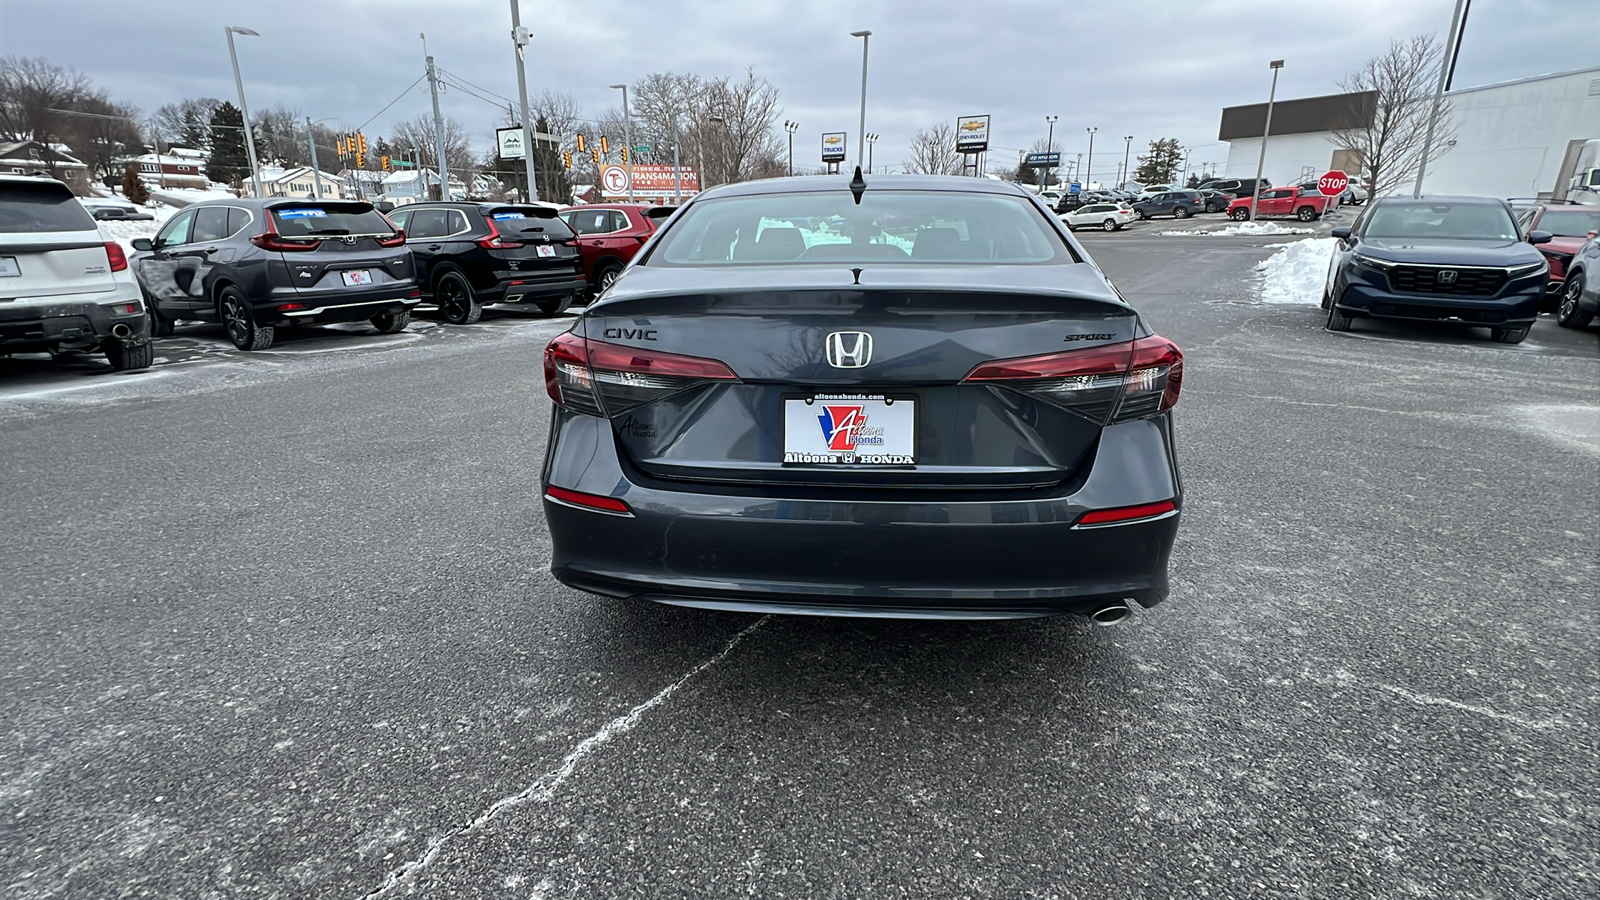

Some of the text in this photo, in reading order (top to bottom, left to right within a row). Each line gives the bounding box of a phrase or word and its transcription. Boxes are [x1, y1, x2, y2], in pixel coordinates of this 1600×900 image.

[1320, 178, 1346, 188] STOP
[603, 328, 658, 341] CIVIC
[1063, 333, 1117, 342] SPORT
[620, 415, 654, 437] Altoona
[828, 410, 884, 445] Altoona
[632, 429, 656, 438] Honda
[850, 435, 883, 444] Honda
[784, 452, 838, 463] Altoona
[860, 455, 914, 464] HONDA
